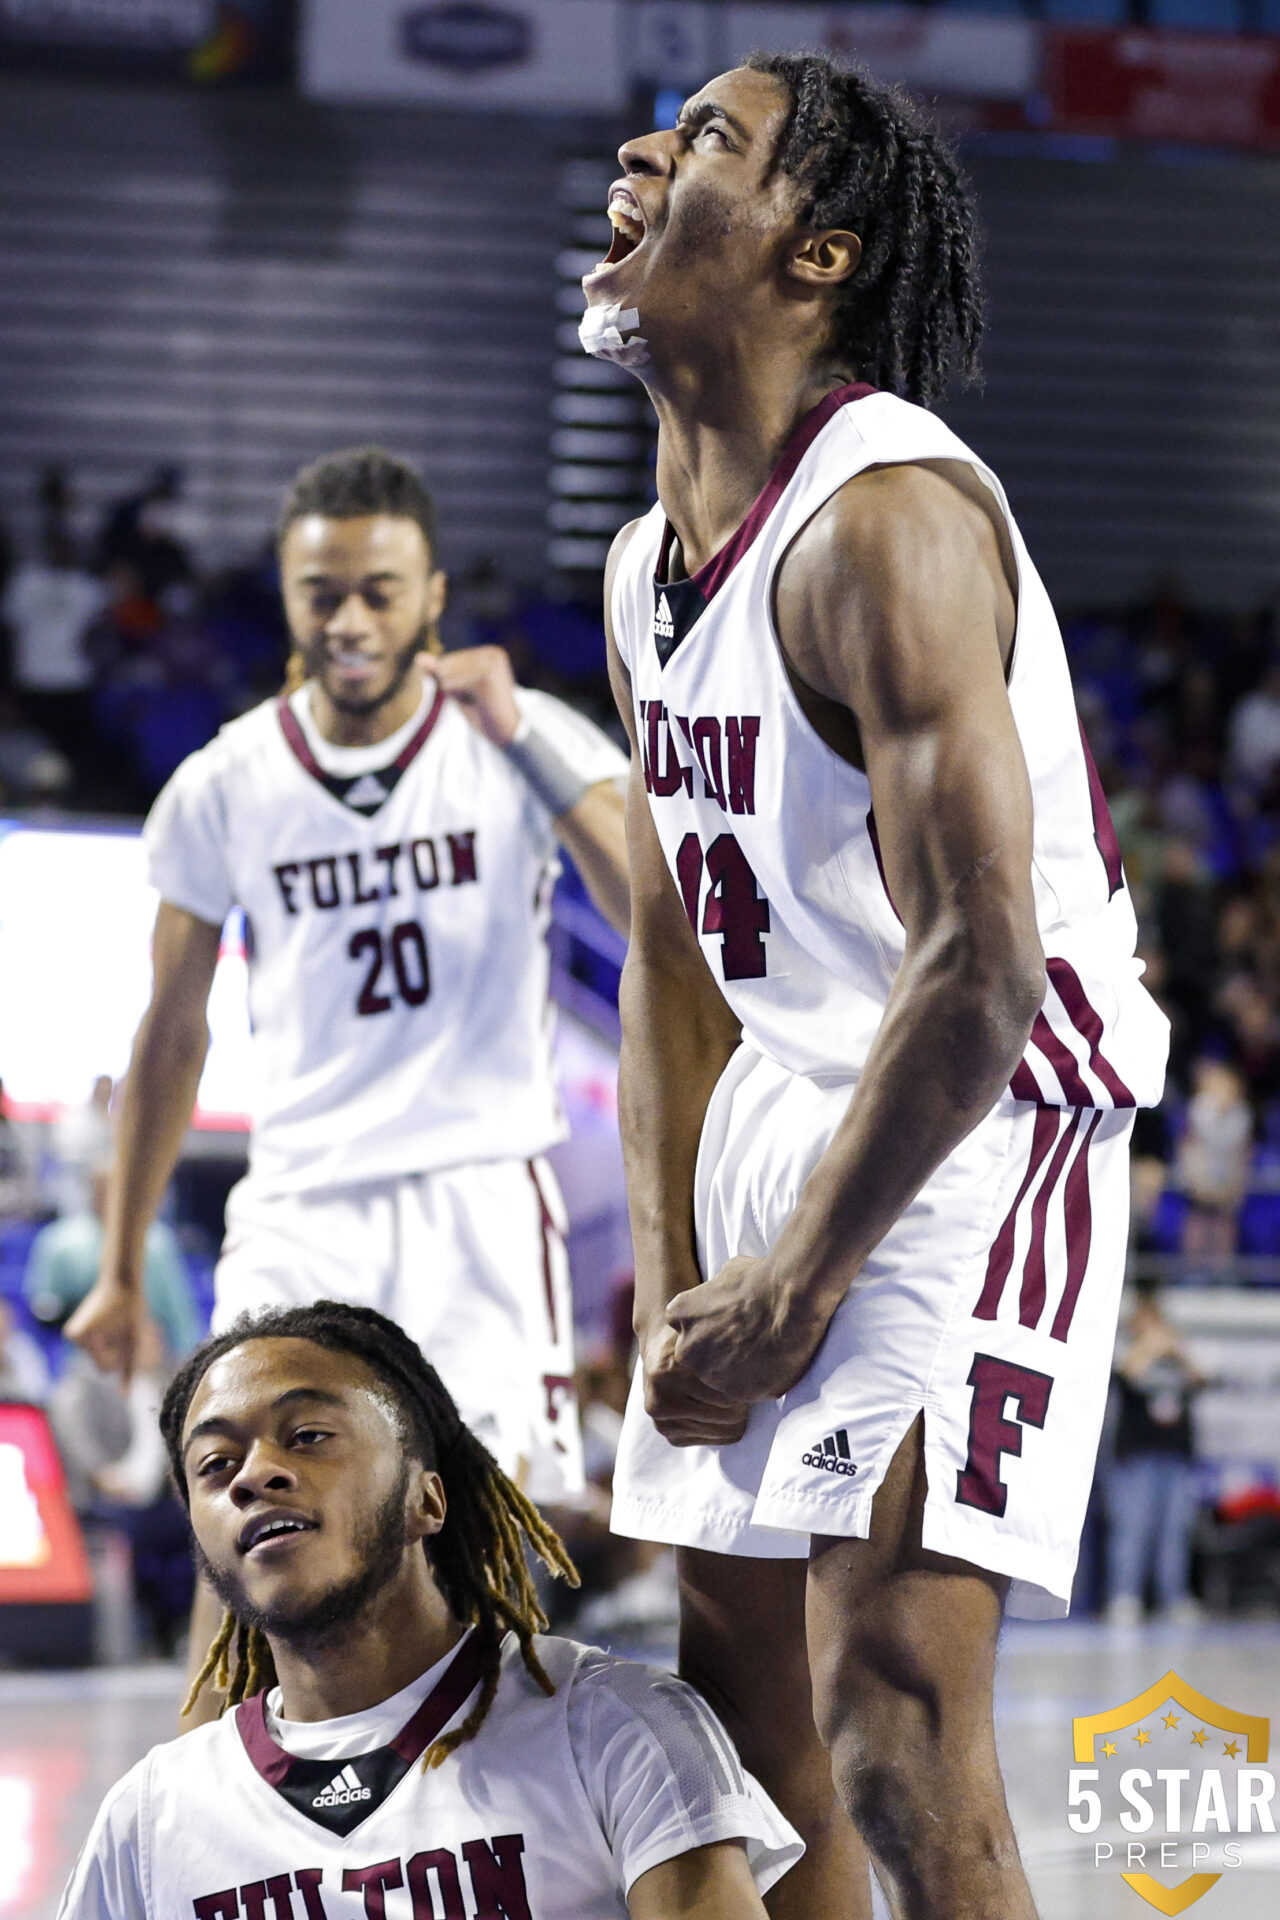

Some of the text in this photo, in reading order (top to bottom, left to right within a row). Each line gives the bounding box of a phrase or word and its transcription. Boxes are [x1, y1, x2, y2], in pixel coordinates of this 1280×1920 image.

[273, 831, 478, 914] FULTON
[676, 832, 771, 981] 14
[348, 921, 431, 1016] 20
[802, 1452, 857, 1477] adidas
[955, 1352, 1054, 1518] F
[312, 1787, 371, 1808] adidas
